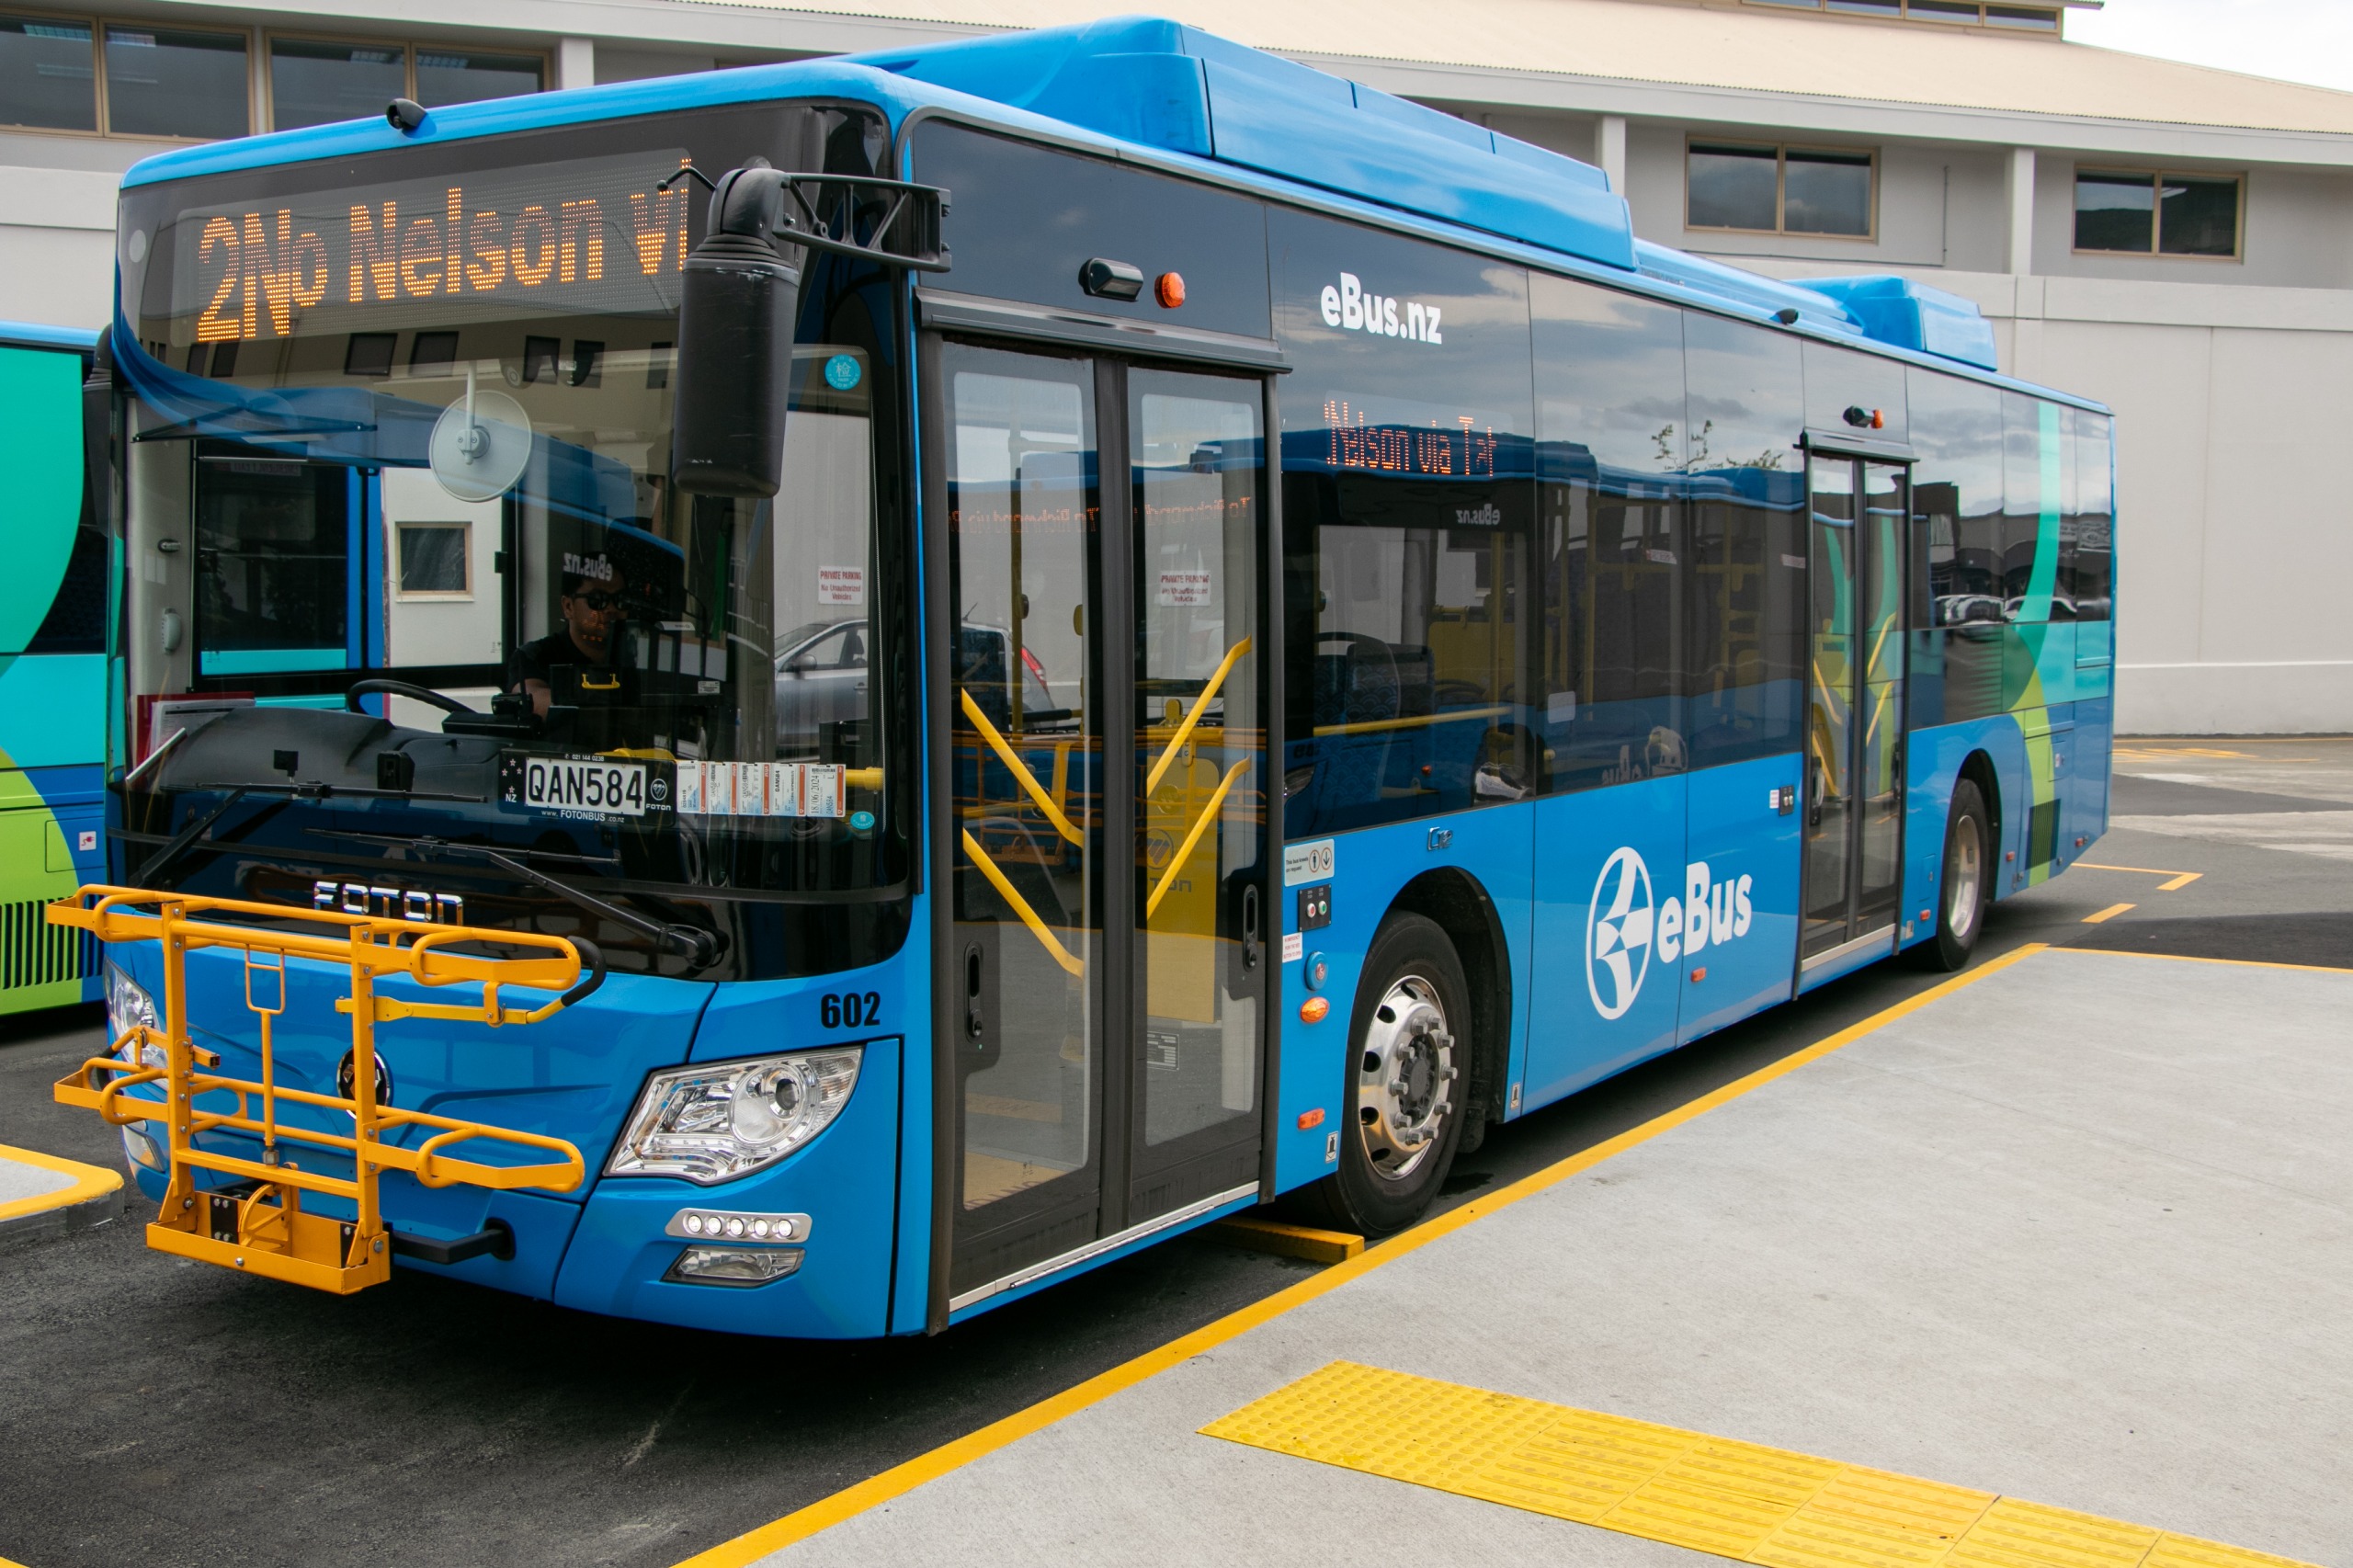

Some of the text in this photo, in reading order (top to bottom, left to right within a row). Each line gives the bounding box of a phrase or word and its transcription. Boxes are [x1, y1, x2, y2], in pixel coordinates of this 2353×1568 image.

[348, 187, 603, 302] Nelson
[1321, 272, 1442, 345] eBus.nz
[1327, 400, 1409, 471] Nelson
[1418, 420, 1451, 474] via
[820, 571, 862, 580] PRIVATE PARKING
[505, 794, 517, 802] NZ
[528, 764, 642, 810] QAN584
[811, 775, 820, 814] 18/06/2024
[314, 881, 464, 926] FOTON
[1657, 861, 1753, 963] eBus
[820, 991, 881, 1029] 602
